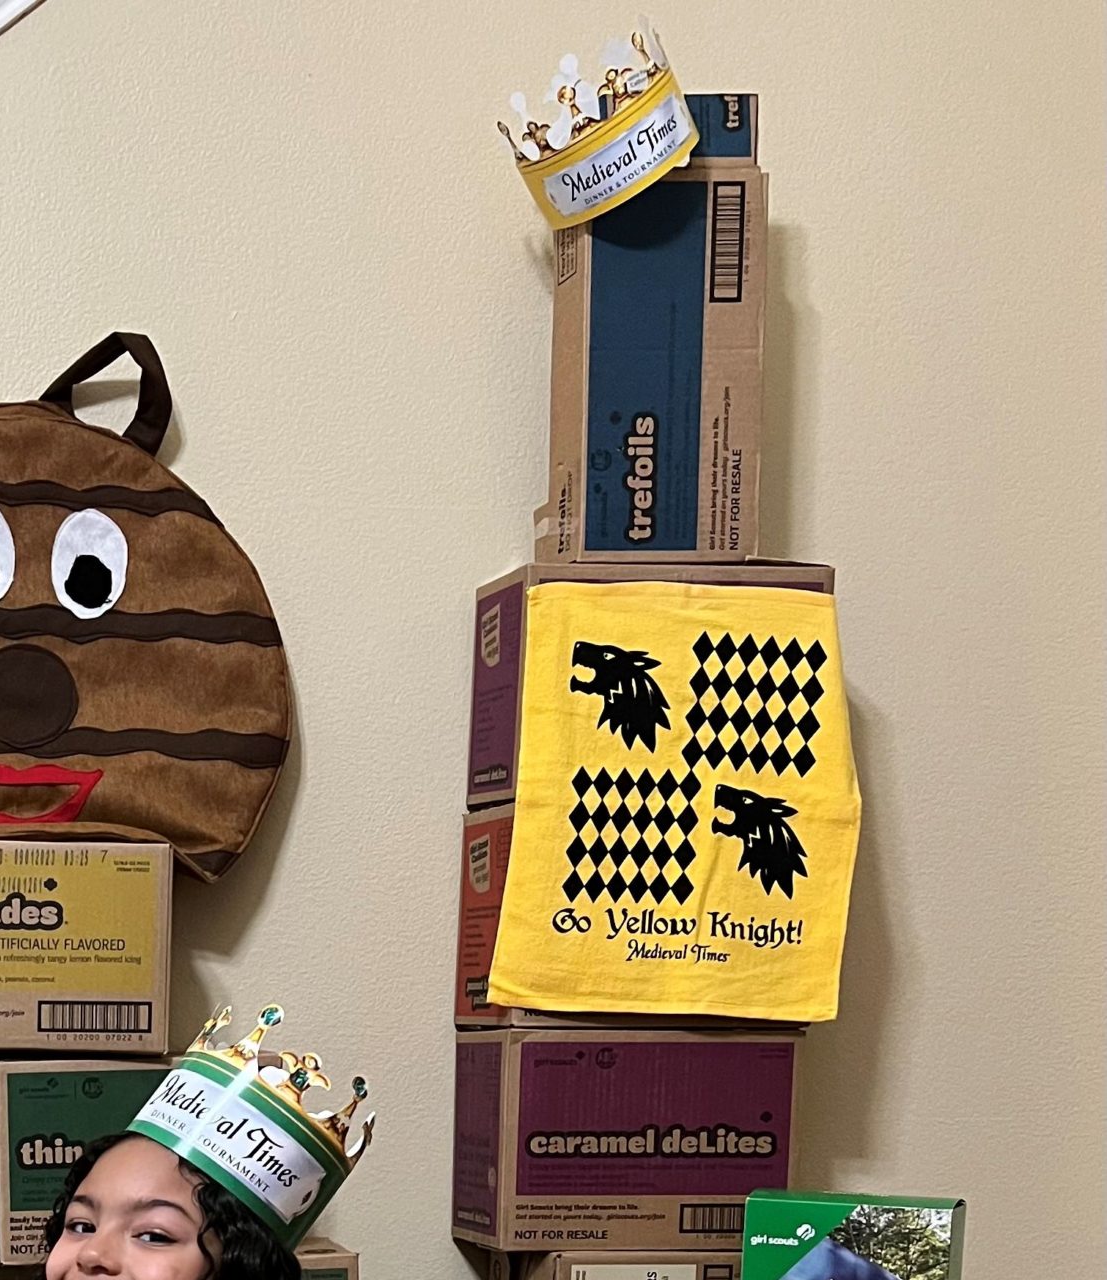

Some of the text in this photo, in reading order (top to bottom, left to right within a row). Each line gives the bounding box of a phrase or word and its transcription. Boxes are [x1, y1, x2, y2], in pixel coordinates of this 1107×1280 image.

[562, 114, 678, 202] Medieval Times
[584, 140, 676, 205] DINNER TOURNAMENT
[627, 416, 654, 540] trefoils
[729, 449, 743, 551] NOT FOR RESALE
[64, 938, 126, 952] FLAVORED
[552, 907, 803, 949] Go Yellow Knight!
[626, 939, 730, 964] Medieval Times
[150, 1111, 187, 1131] DINNER
[20, 1137, 84, 1166] thin
[243, 1128, 300, 1187] Times
[529, 1128, 774, 1155] caramel deLites
[750, 1233, 799, 1246] girl scouts
